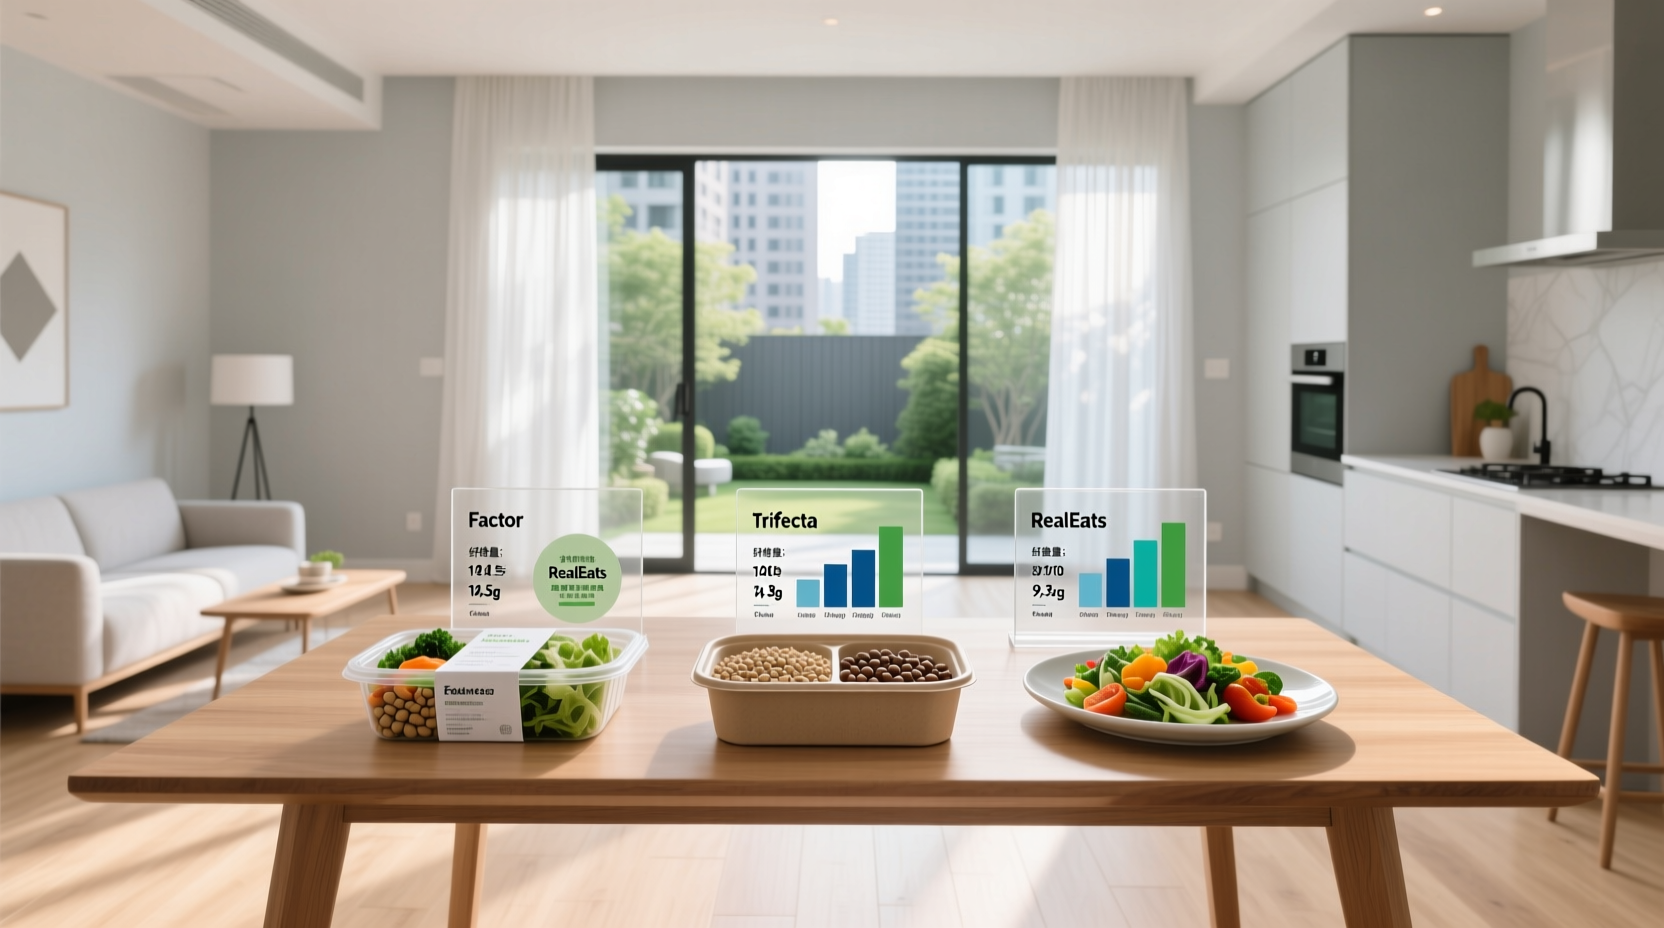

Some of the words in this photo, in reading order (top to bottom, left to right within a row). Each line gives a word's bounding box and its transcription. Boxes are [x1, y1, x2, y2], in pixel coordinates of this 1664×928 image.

[468, 511, 524, 528] Factor
[752, 511, 818, 528] Trifecta
[1031, 511, 1107, 528] RealEats
[548, 565, 607, 579] RealEats
